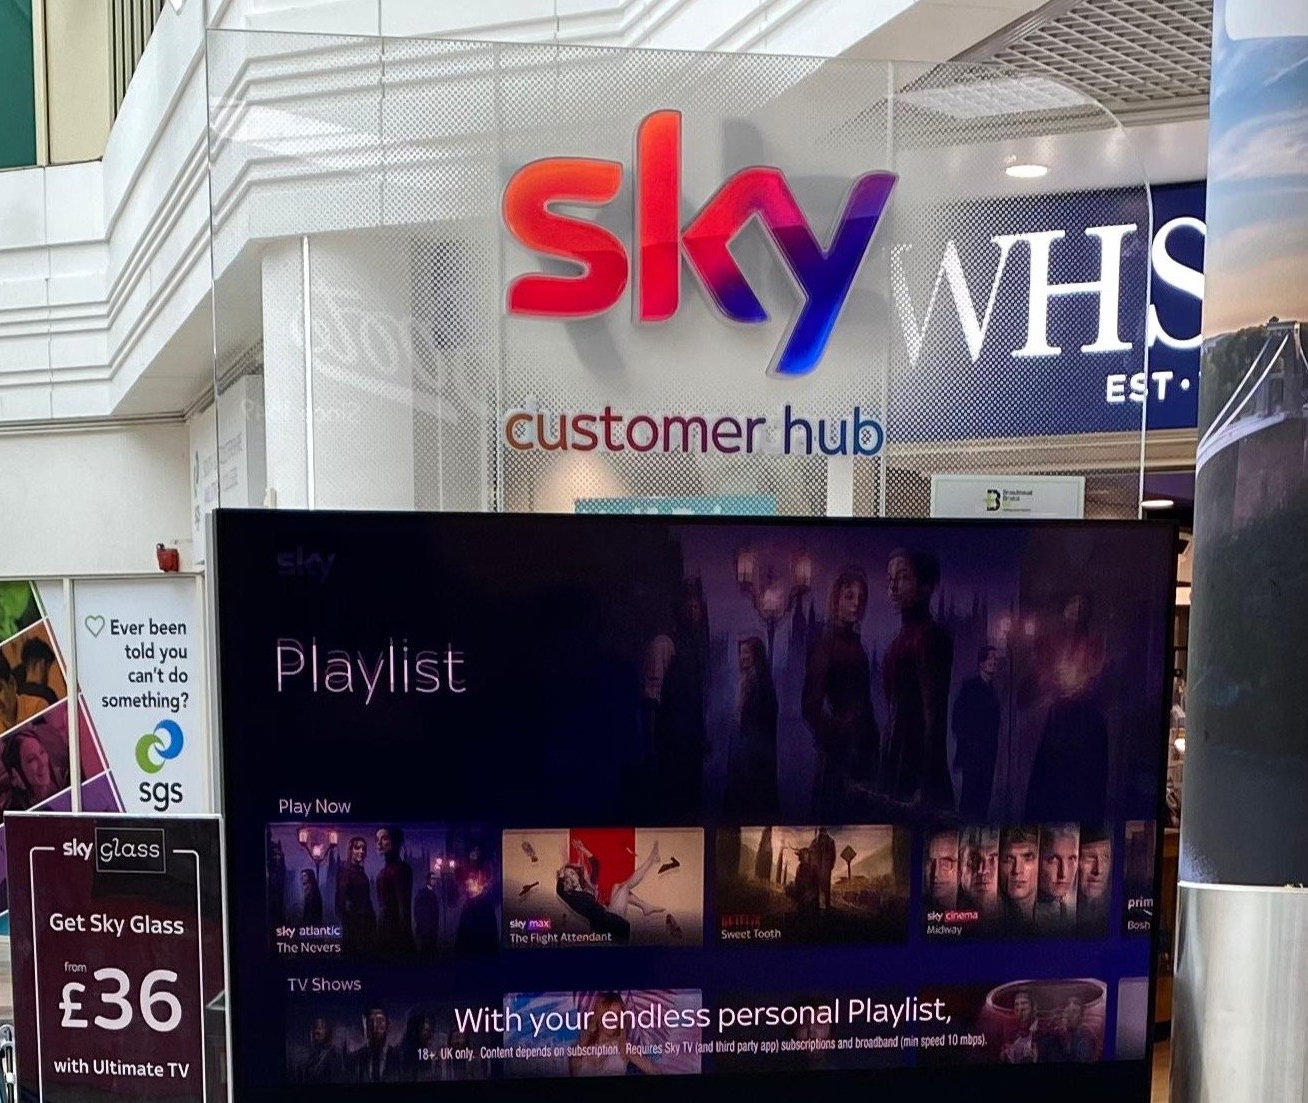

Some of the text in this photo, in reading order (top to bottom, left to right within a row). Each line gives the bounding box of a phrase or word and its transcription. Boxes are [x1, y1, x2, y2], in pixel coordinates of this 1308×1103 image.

[502, 109, 898, 379] sky
[505, 406, 885, 456] customer hub
[110, 618, 187, 635] Ever been
[125, 642, 187, 664] told you
[128, 666, 188, 683] can't do
[276, 637, 468, 704] Playlist
[101, 692, 189, 713] something?
[139, 782, 184, 812] sgs
[279, 798, 351, 817] Play Now
[63, 837, 160, 862] sky glass
[50, 913, 185, 937] Get Sky Glass
[510, 919, 549, 930] sky max
[927, 910, 978, 922] sky cinema
[276, 925, 341, 940] sky atlantic
[510, 931, 612, 945] The Flight Attendant
[721, 928, 781, 940] Sweet Tooth
[927, 924, 962, 936] Midway
[276, 942, 341, 954] The Nevers
[64, 961, 87, 973] from
[288, 977, 362, 991] TV Shows
[59, 967, 182, 1033] £36
[454, 997, 952, 1038] With your endless personal Playlist,
[440, 1048, 453, 1060] UK
[480, 1047, 513, 1059] Content
[516, 1046, 551, 1061] depends
[553, 1047, 564, 1057] on
[567, 1045, 620, 1060] subscription.
[626, 1043, 663, 1057] Requires
[665, 1042, 680, 1055] Sky
[682, 1042, 693, 1053] TV
[695, 1041, 713, 1055] (and
[715, 1040, 735, 1053] third
[737, 1040, 758, 1055] party
[760, 1039, 779, 1055] app)
[781, 1037, 835, 1052] subscriptions
[838, 1037, 853, 1050] and
[855, 1035, 898, 1049] broadband
[900, 1035, 918, 1050] (min
[921, 1034, 945, 1049] speed
[948, 1034, 958, 1045] 10
[960, 1033, 987, 1048] mbps).
[54, 1058, 189, 1078] with Ultimate TV
